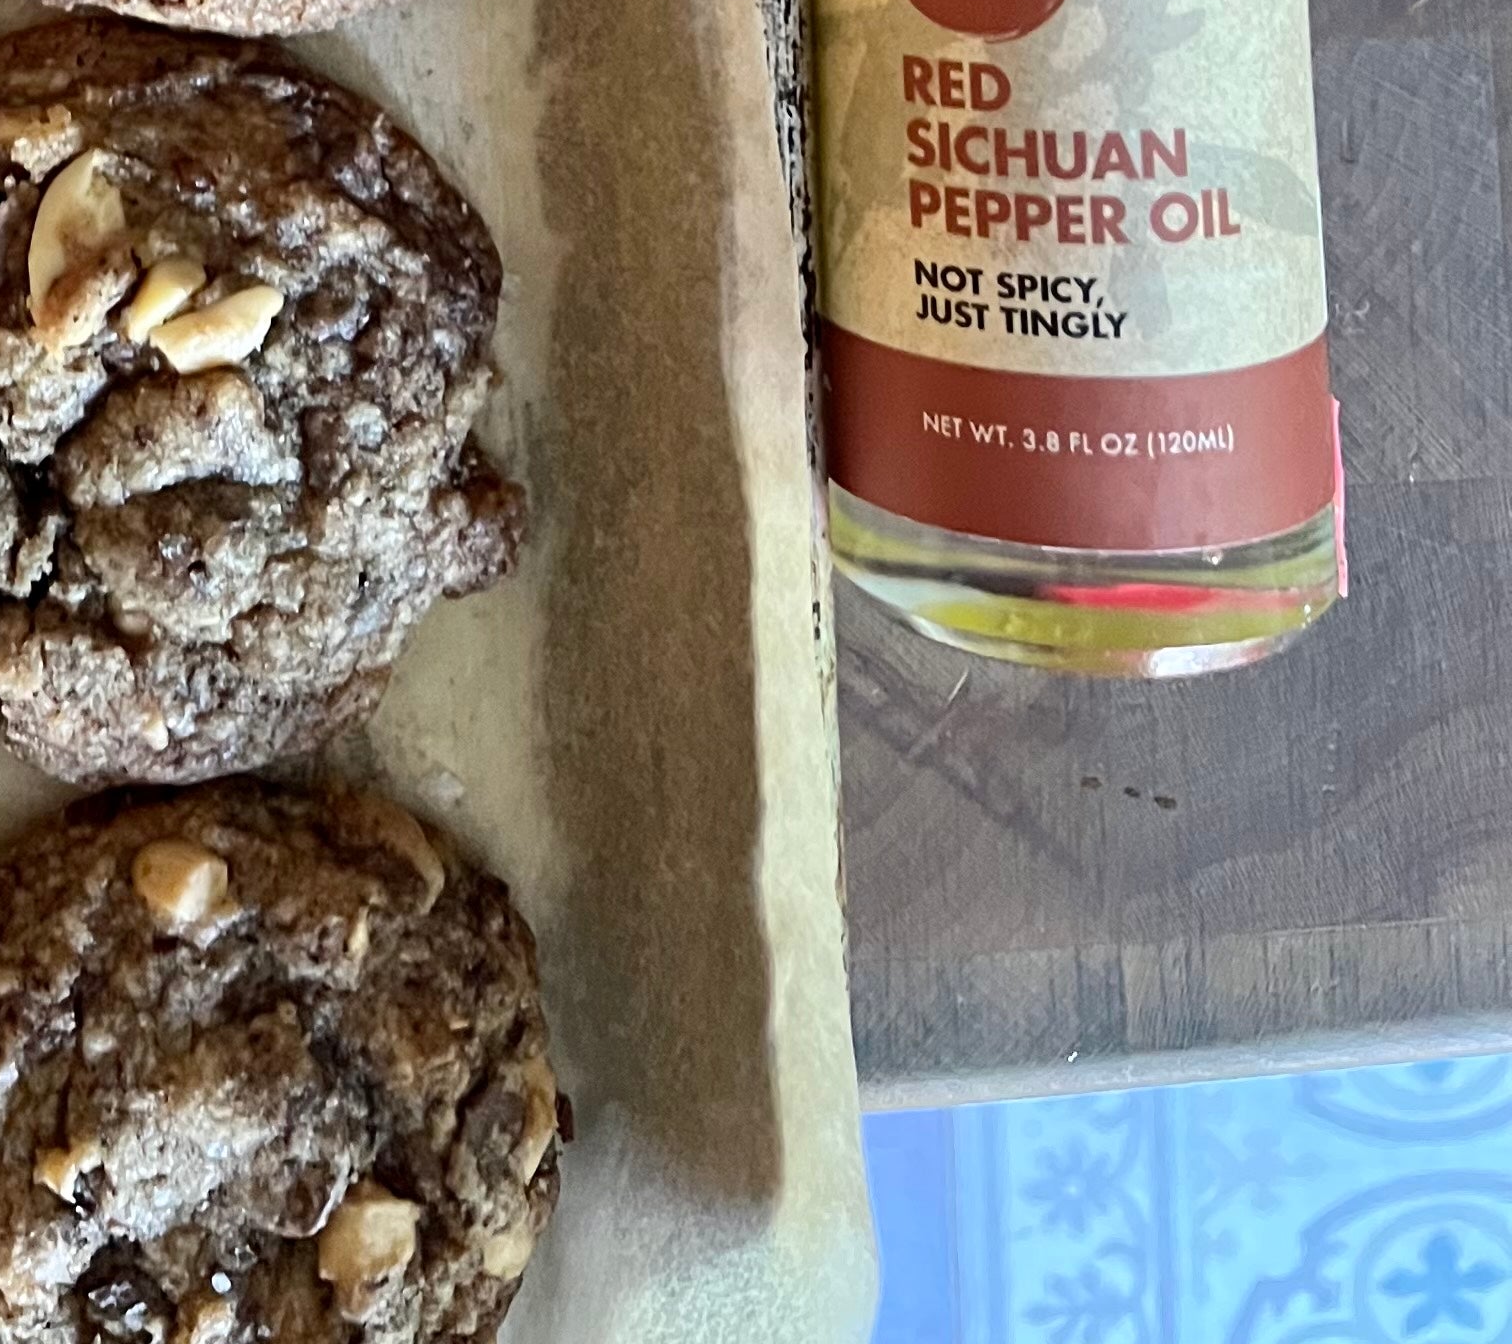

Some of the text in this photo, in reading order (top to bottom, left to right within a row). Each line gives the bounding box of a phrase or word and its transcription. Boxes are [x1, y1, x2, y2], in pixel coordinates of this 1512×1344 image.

[902, 54, 1012, 113] RED
[906, 117, 1188, 181] SICHUAN
[908, 178, 1241, 245] PEPPER OIL
[914, 258, 1105, 309] NOT SPICY,
[916, 293, 1128, 339] JUST TINGLY
[922, 411, 1235, 459] NET WT. 3.8 FL OZ (120ML)
